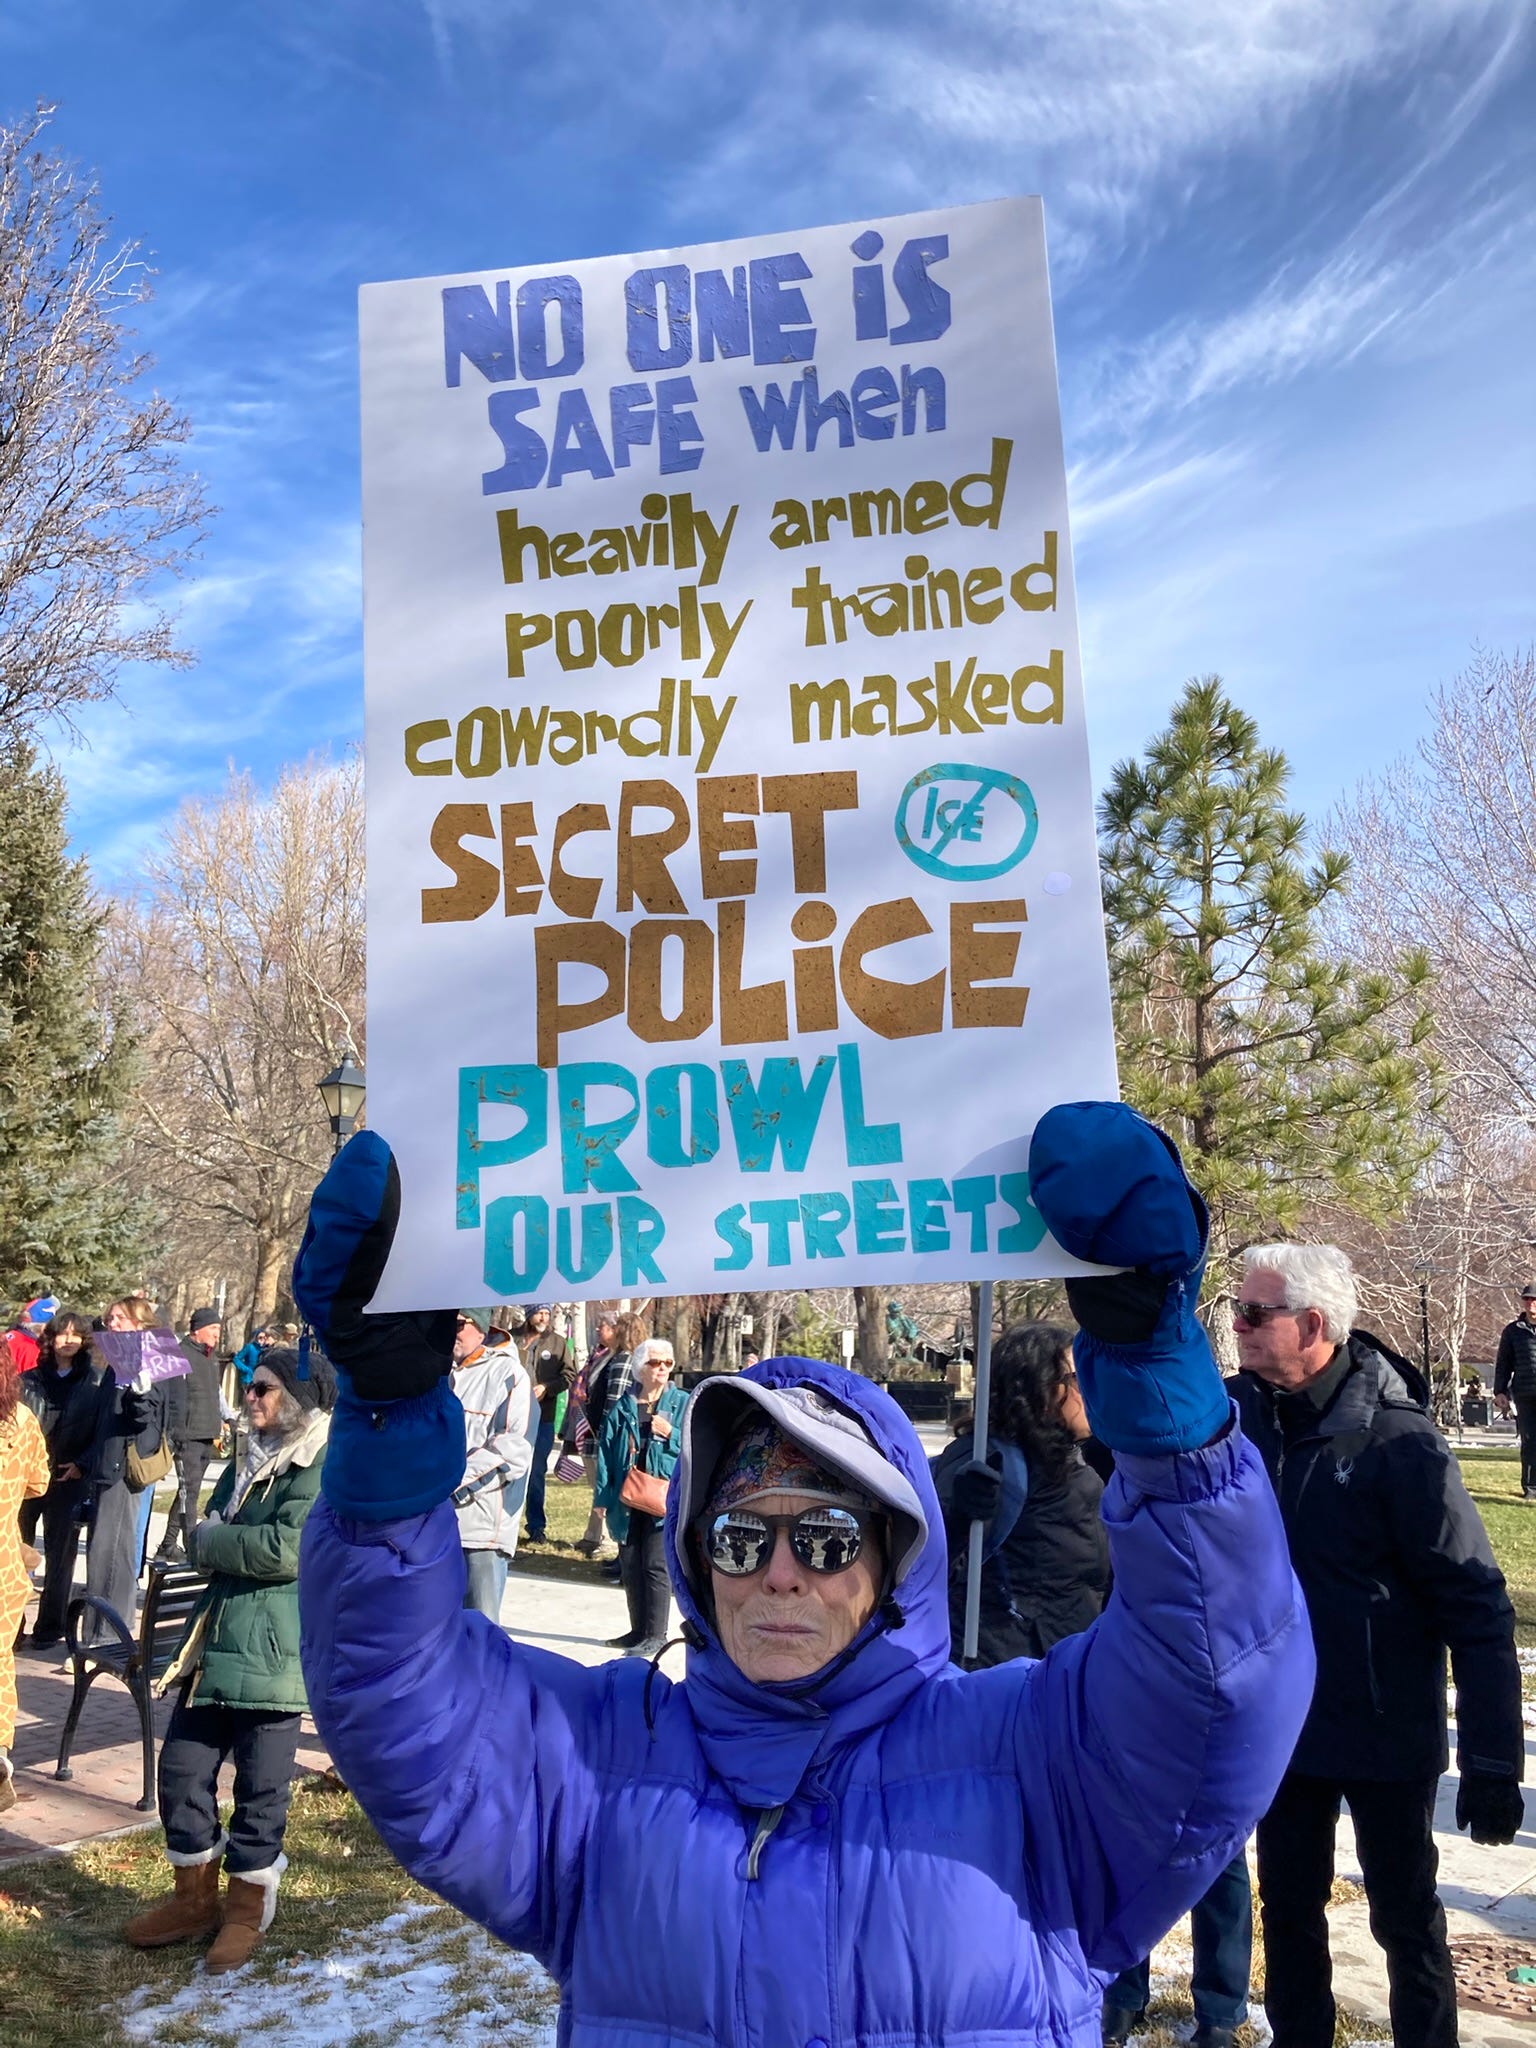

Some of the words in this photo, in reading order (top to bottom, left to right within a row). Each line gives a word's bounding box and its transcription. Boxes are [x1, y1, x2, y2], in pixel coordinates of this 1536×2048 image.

[442, 276, 584, 388] NO
[626, 252, 817, 372] ONE
[481, 376, 704, 495] SAFE
[495, 492, 740, 587] heavily
[769, 437, 1015, 550] armed
[791, 530, 1058, 647] trained
[421, 771, 859, 924] SECRET
[921, 787, 984, 842] ICE
[455, 1042, 902, 1230] PROWL
[483, 1195, 667, 1297] OUR
[713, 1171, 1048, 1272] STREETS
